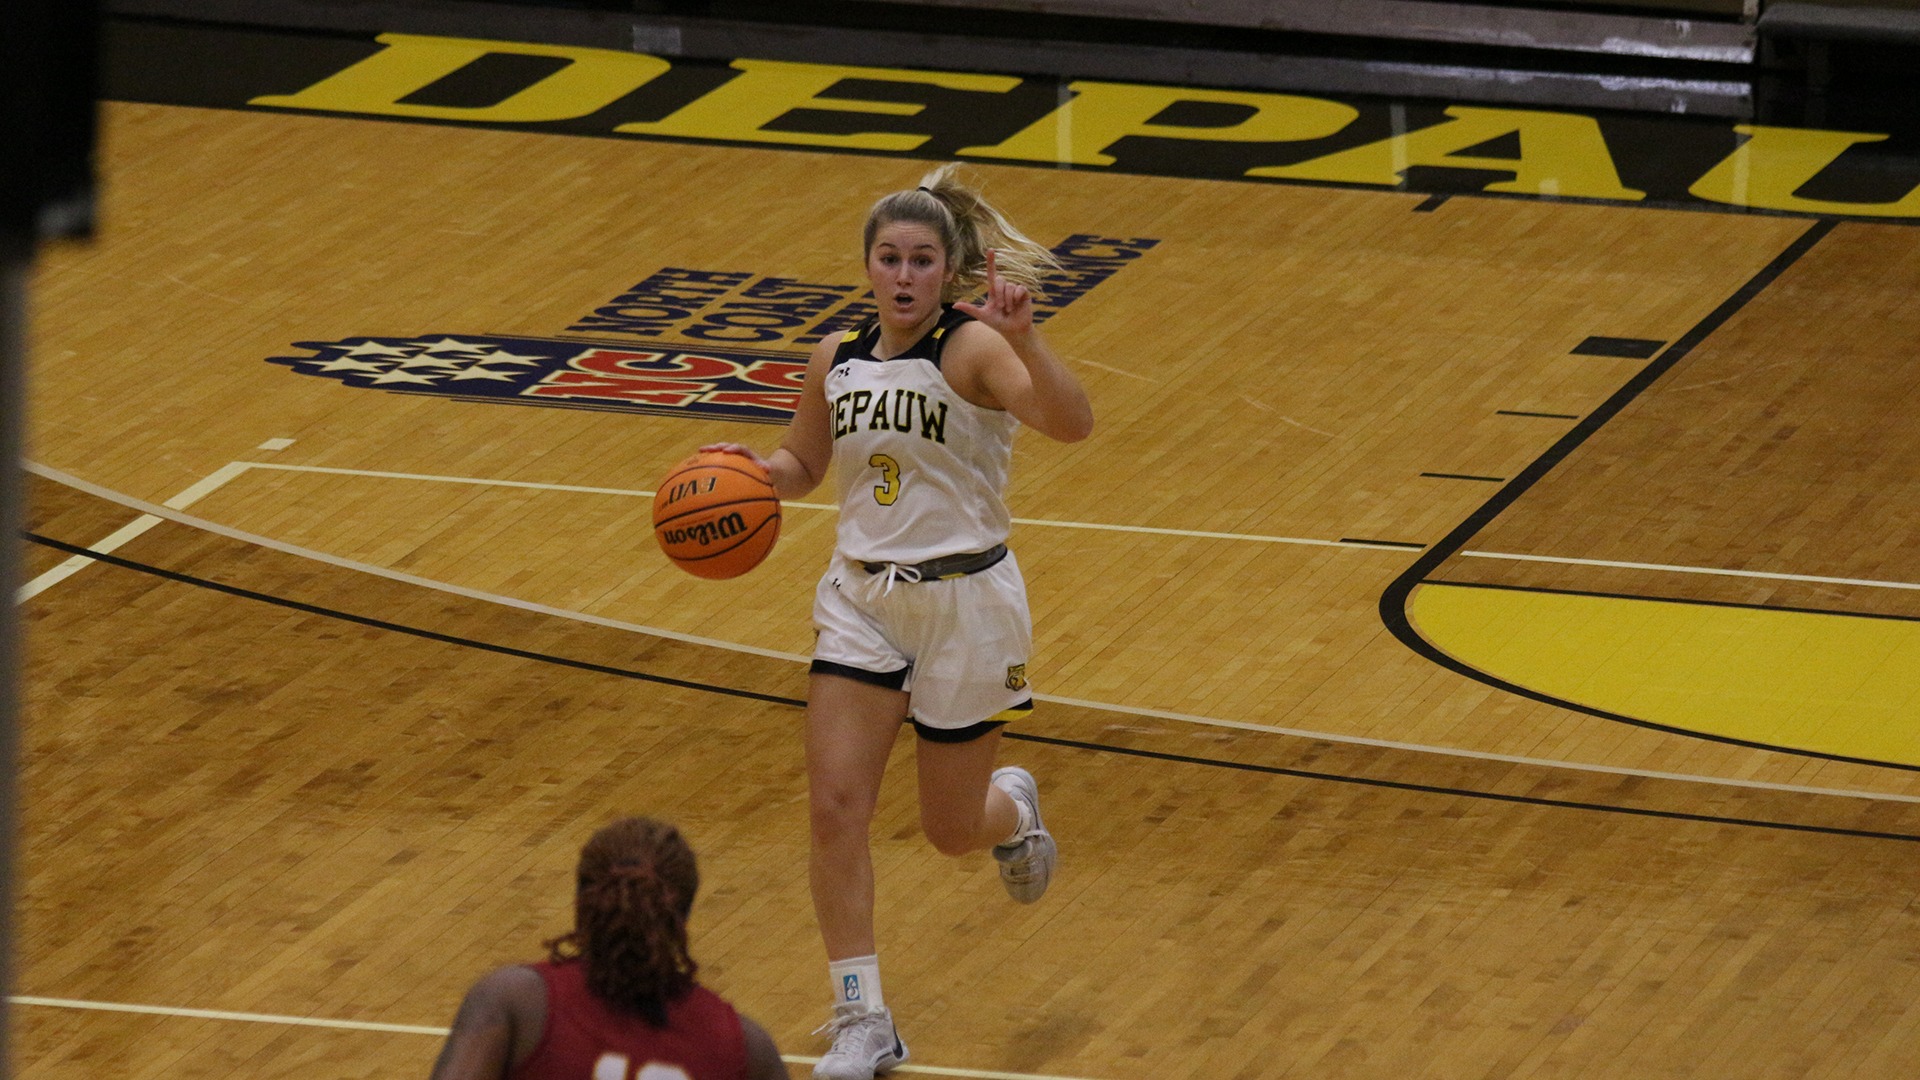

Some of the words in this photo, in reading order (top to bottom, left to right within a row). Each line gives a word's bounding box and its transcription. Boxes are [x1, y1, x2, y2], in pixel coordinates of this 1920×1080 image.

[564, 267, 755, 336] NORTH
[681, 277, 859, 343] COAST
[868, 453, 901, 506] 3
[663, 512, 748, 546] Wilson
